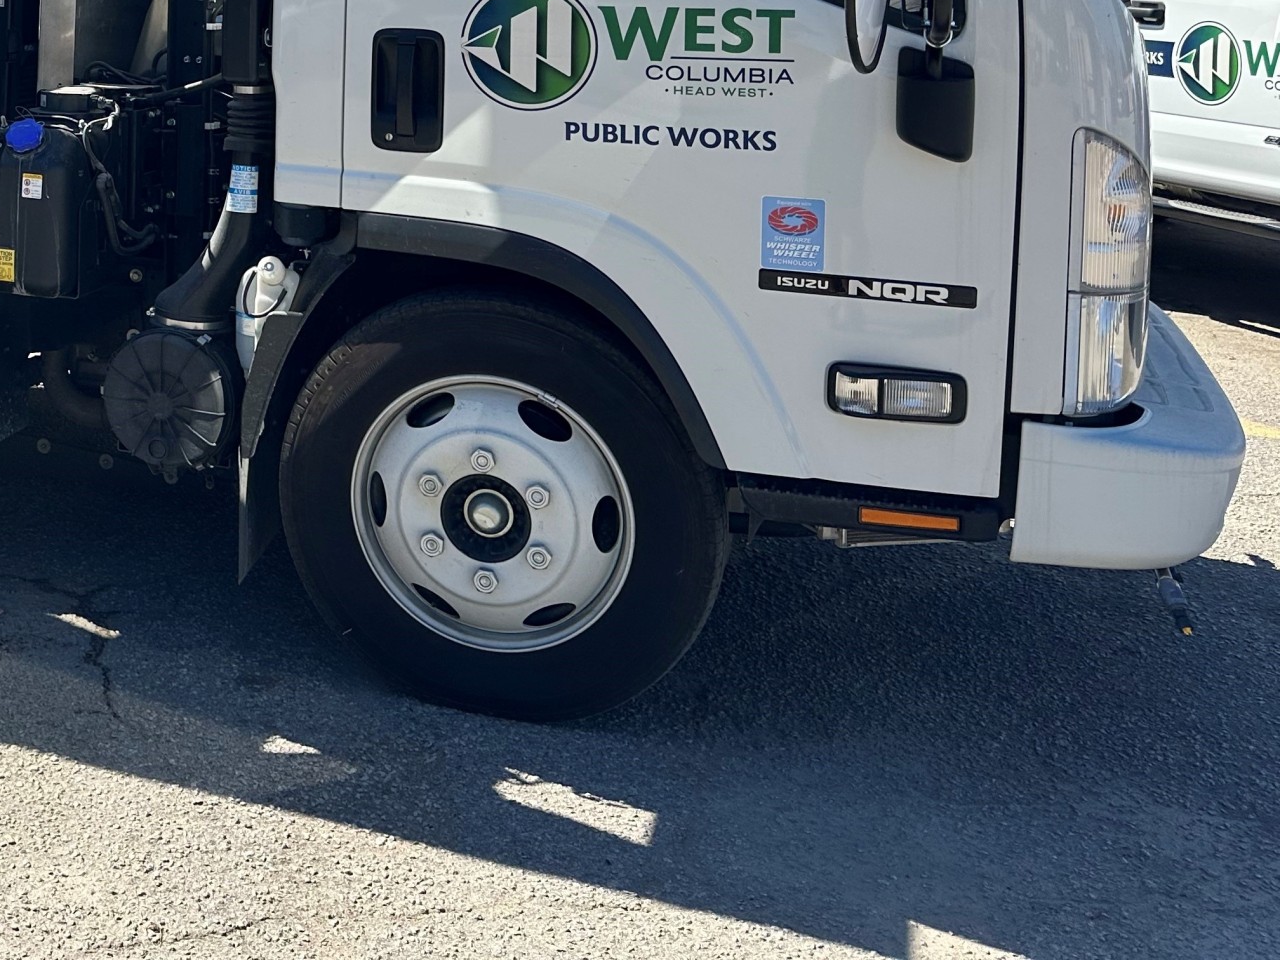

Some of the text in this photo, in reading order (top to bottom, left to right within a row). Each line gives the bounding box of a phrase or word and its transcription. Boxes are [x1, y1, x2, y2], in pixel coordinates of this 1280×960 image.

[597, 5, 796, 62] WEST
[1145, 51, 1164, 65] RKS
[645, 64, 794, 85] COLUMBIA
[673, 86, 768, 98] HEAD WEST
[564, 121, 777, 152] PUBLIC WORKS
[766, 241, 821, 252] WHISPER
[774, 235, 813, 244] SCHWARZE
[773, 249, 817, 259] WHEEL
[769, 257, 818, 267] TECHNOLOGY
[777, 276, 829, 290] ISUZU
[848, 279, 949, 304] NQR
